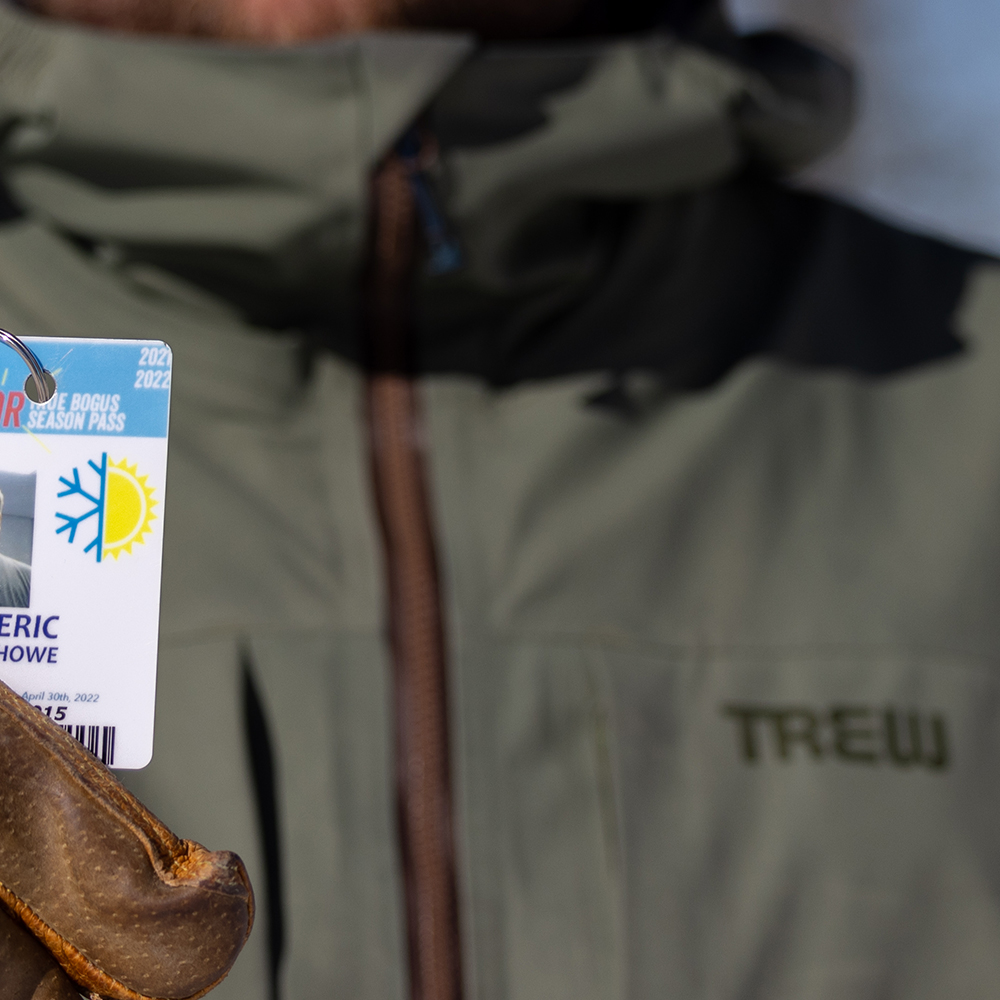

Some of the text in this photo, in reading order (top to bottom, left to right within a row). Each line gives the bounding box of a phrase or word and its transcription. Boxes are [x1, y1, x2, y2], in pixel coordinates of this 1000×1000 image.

[134, 369, 170, 389] 2022
[70, 392, 121, 413] BOGUS
[27, 410, 126, 432] SEASON PASS
[21, 691, 100, 703] April 30th, 2022
[720, 703, 948, 771] TREW
